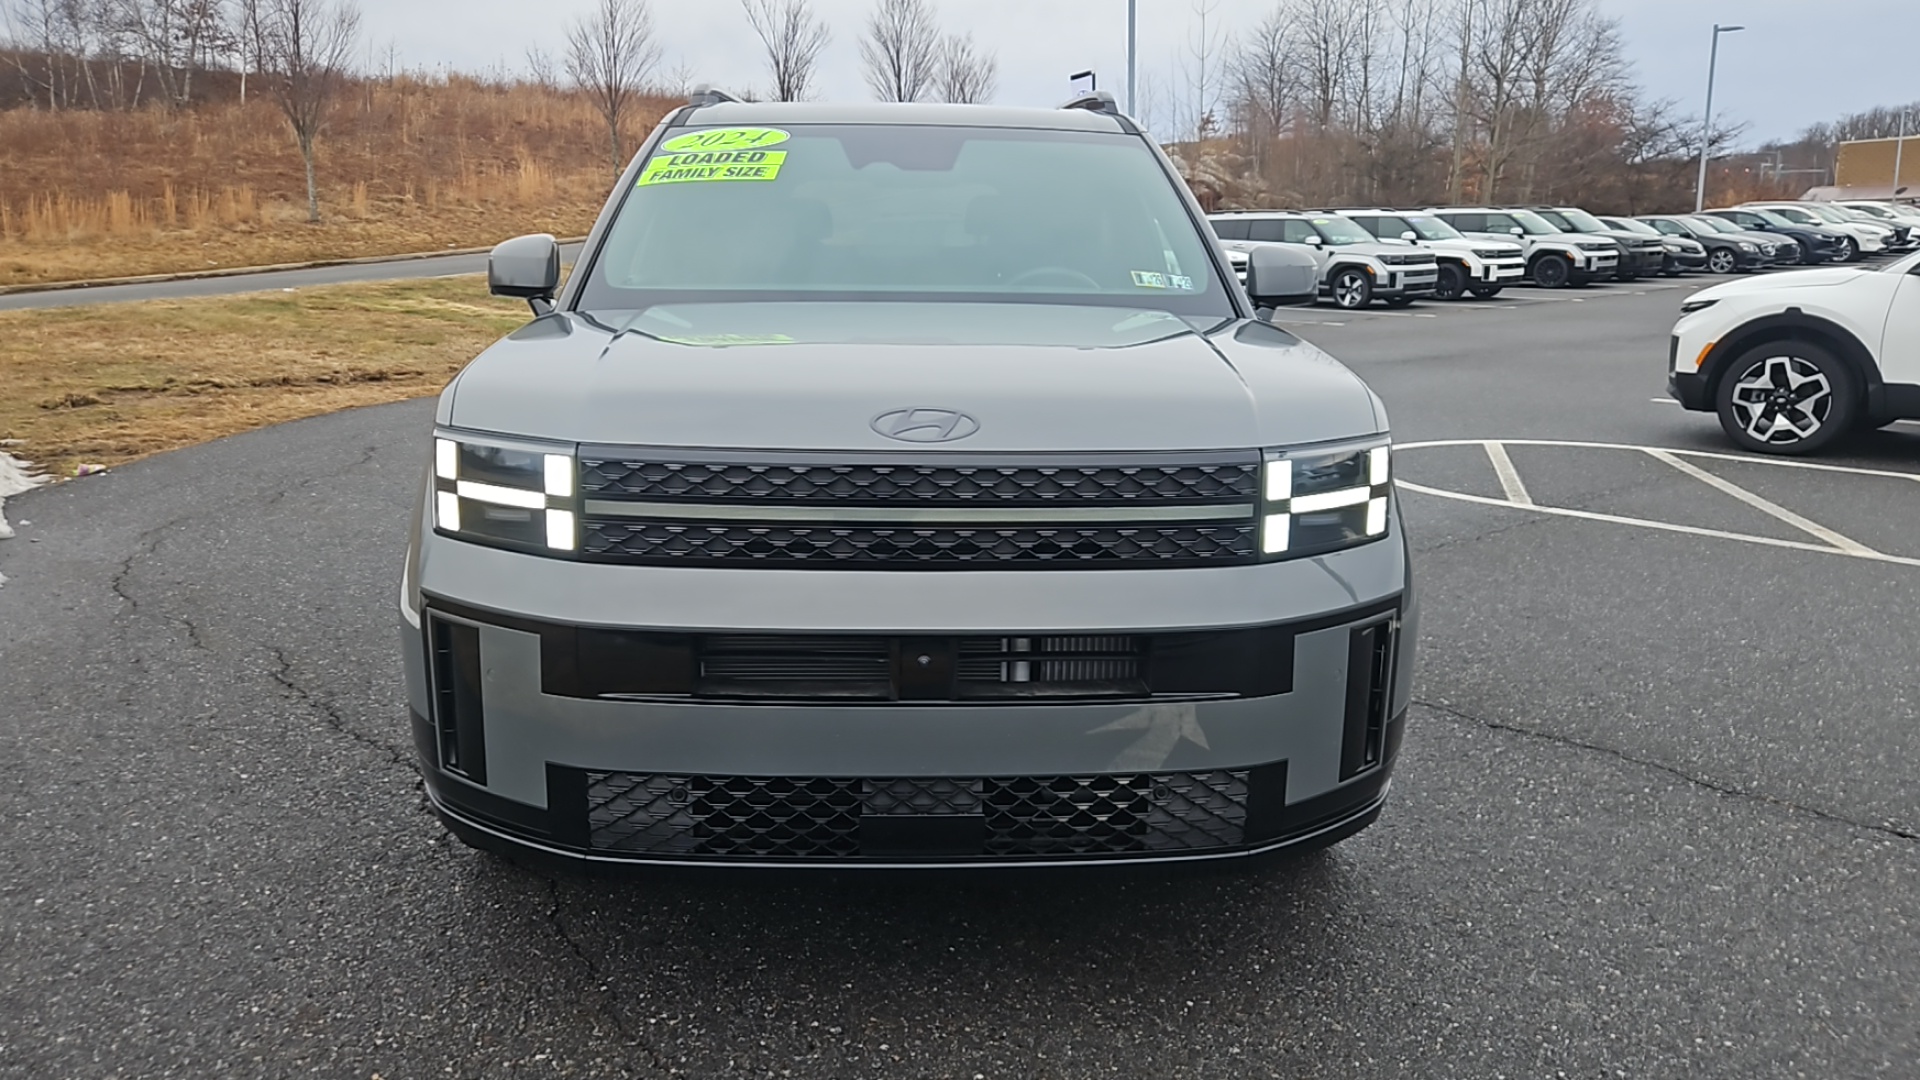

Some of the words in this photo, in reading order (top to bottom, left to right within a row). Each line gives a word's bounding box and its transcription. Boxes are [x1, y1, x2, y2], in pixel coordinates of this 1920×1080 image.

[678, 130, 772, 149] 2024
[668, 151, 767, 166] LOADED
[649, 166, 719, 181] FAMILY
[723, 166, 766, 177] SIZE
